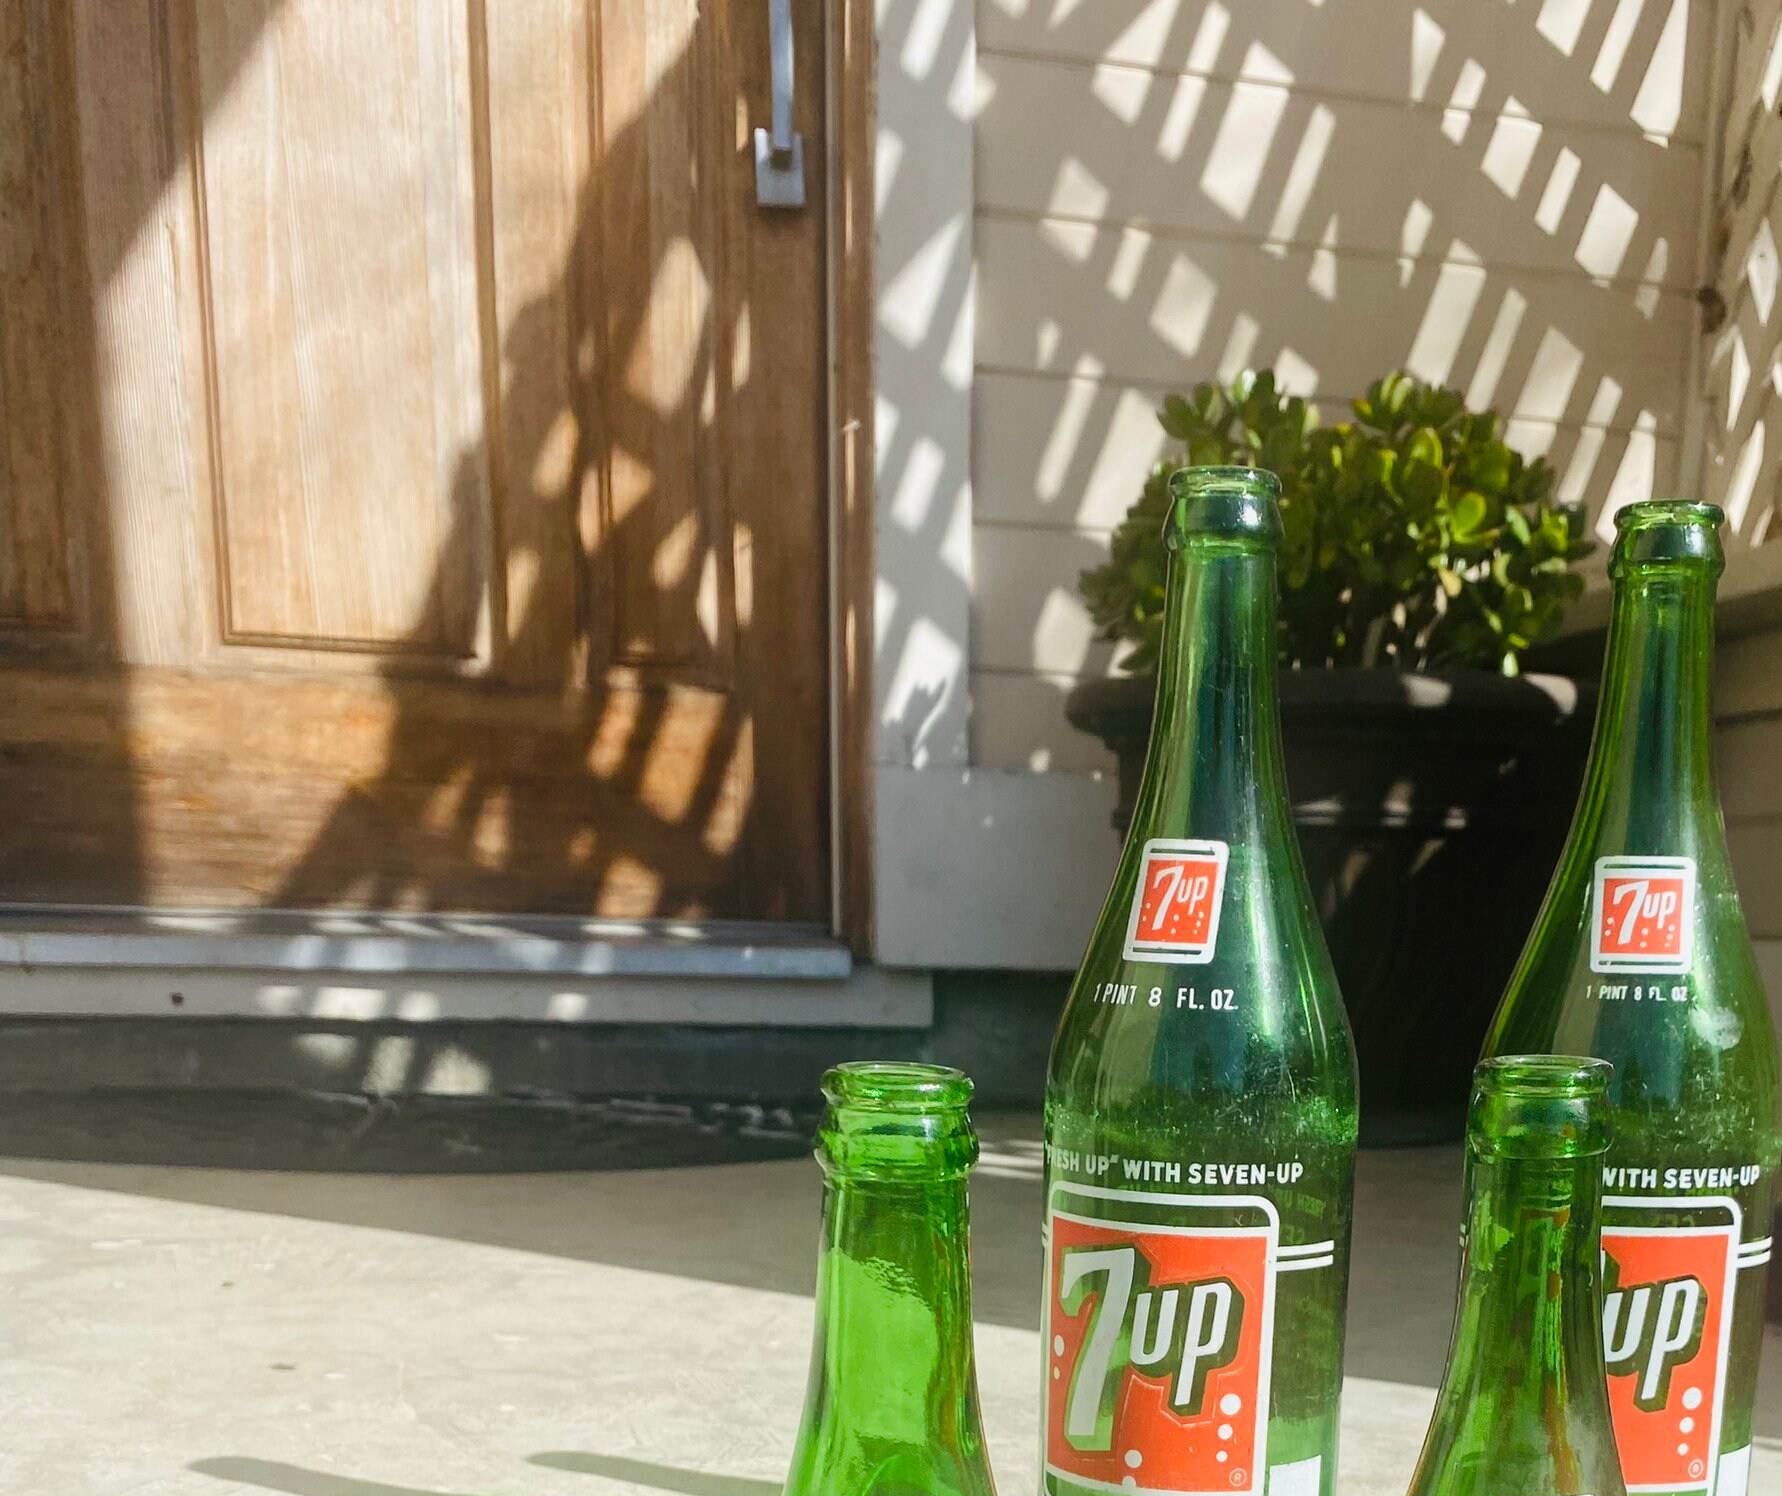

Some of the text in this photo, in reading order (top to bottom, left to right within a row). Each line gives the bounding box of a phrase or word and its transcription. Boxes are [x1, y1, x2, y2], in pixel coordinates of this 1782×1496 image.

[1102, 985, 1138, 1006] PINT
[1148, 987, 1162, 1006] 8
[1176, 988, 1205, 1010] FL.
[1210, 988, 1240, 1011] OZ.
[1599, 985, 1629, 1001] PINT
[1633, 985, 1643, 1001] 8
[1122, 1158, 1181, 1184] WITH
[1187, 1161, 1304, 1186] SEVEN-UP
[1662, 1164, 1761, 1190] SEVEN-UP
[1601, 1258, 1699, 1400] up
